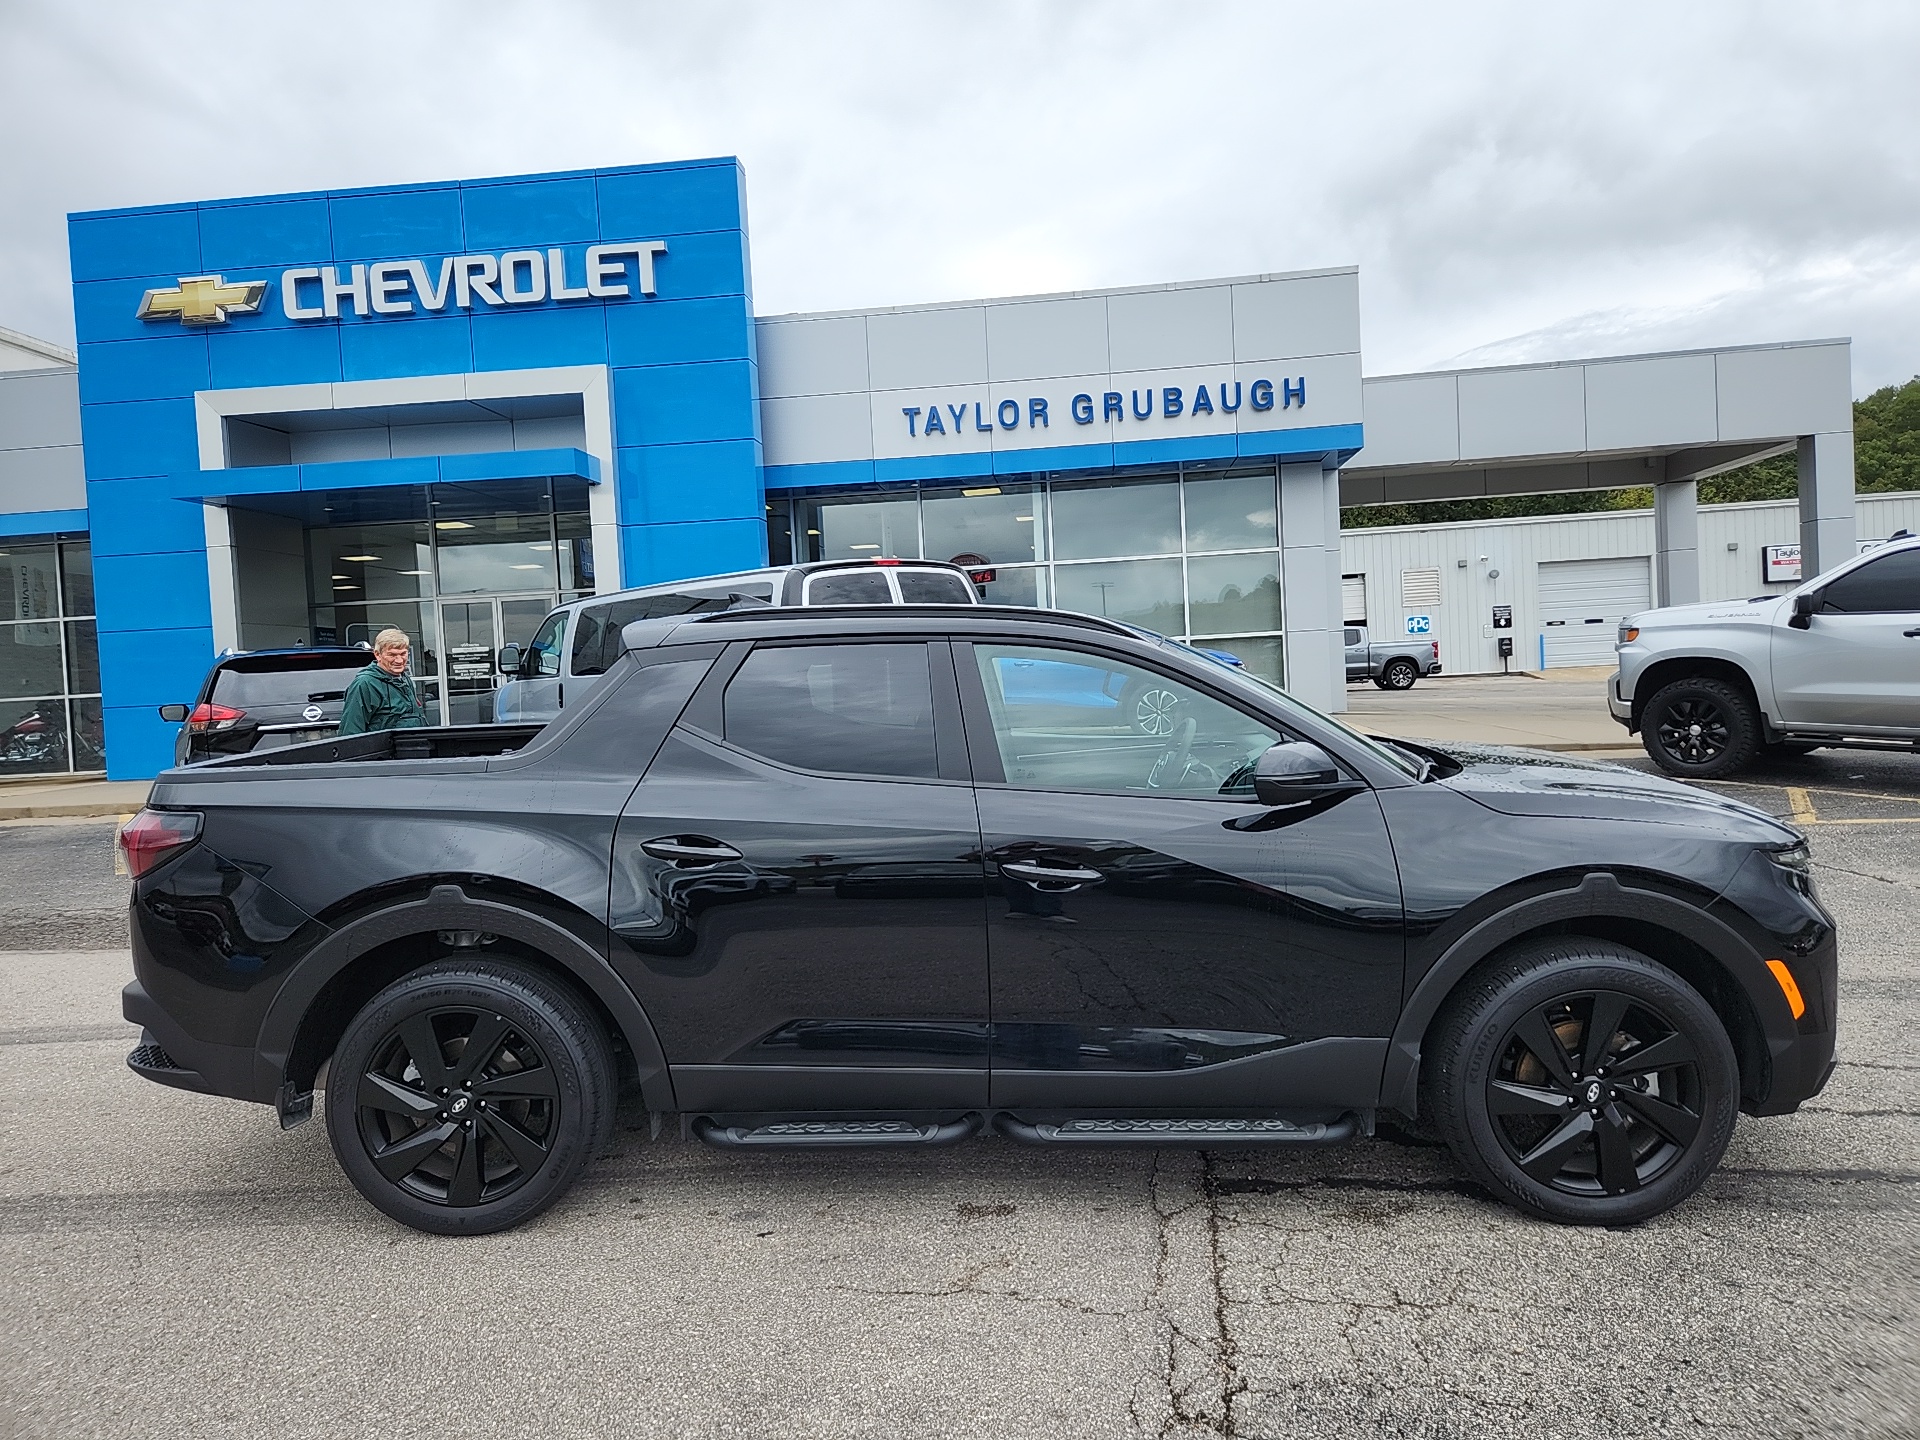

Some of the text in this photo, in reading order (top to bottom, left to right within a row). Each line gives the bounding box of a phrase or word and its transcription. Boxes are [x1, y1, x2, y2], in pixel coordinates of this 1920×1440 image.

[282, 240, 669, 321] CHEVROLET
[901, 376, 1308, 437] TAYLOR GRUBAUGH
[1408, 618, 1429, 632] PPG
[1468, 1022, 1499, 1084] KUMHO
